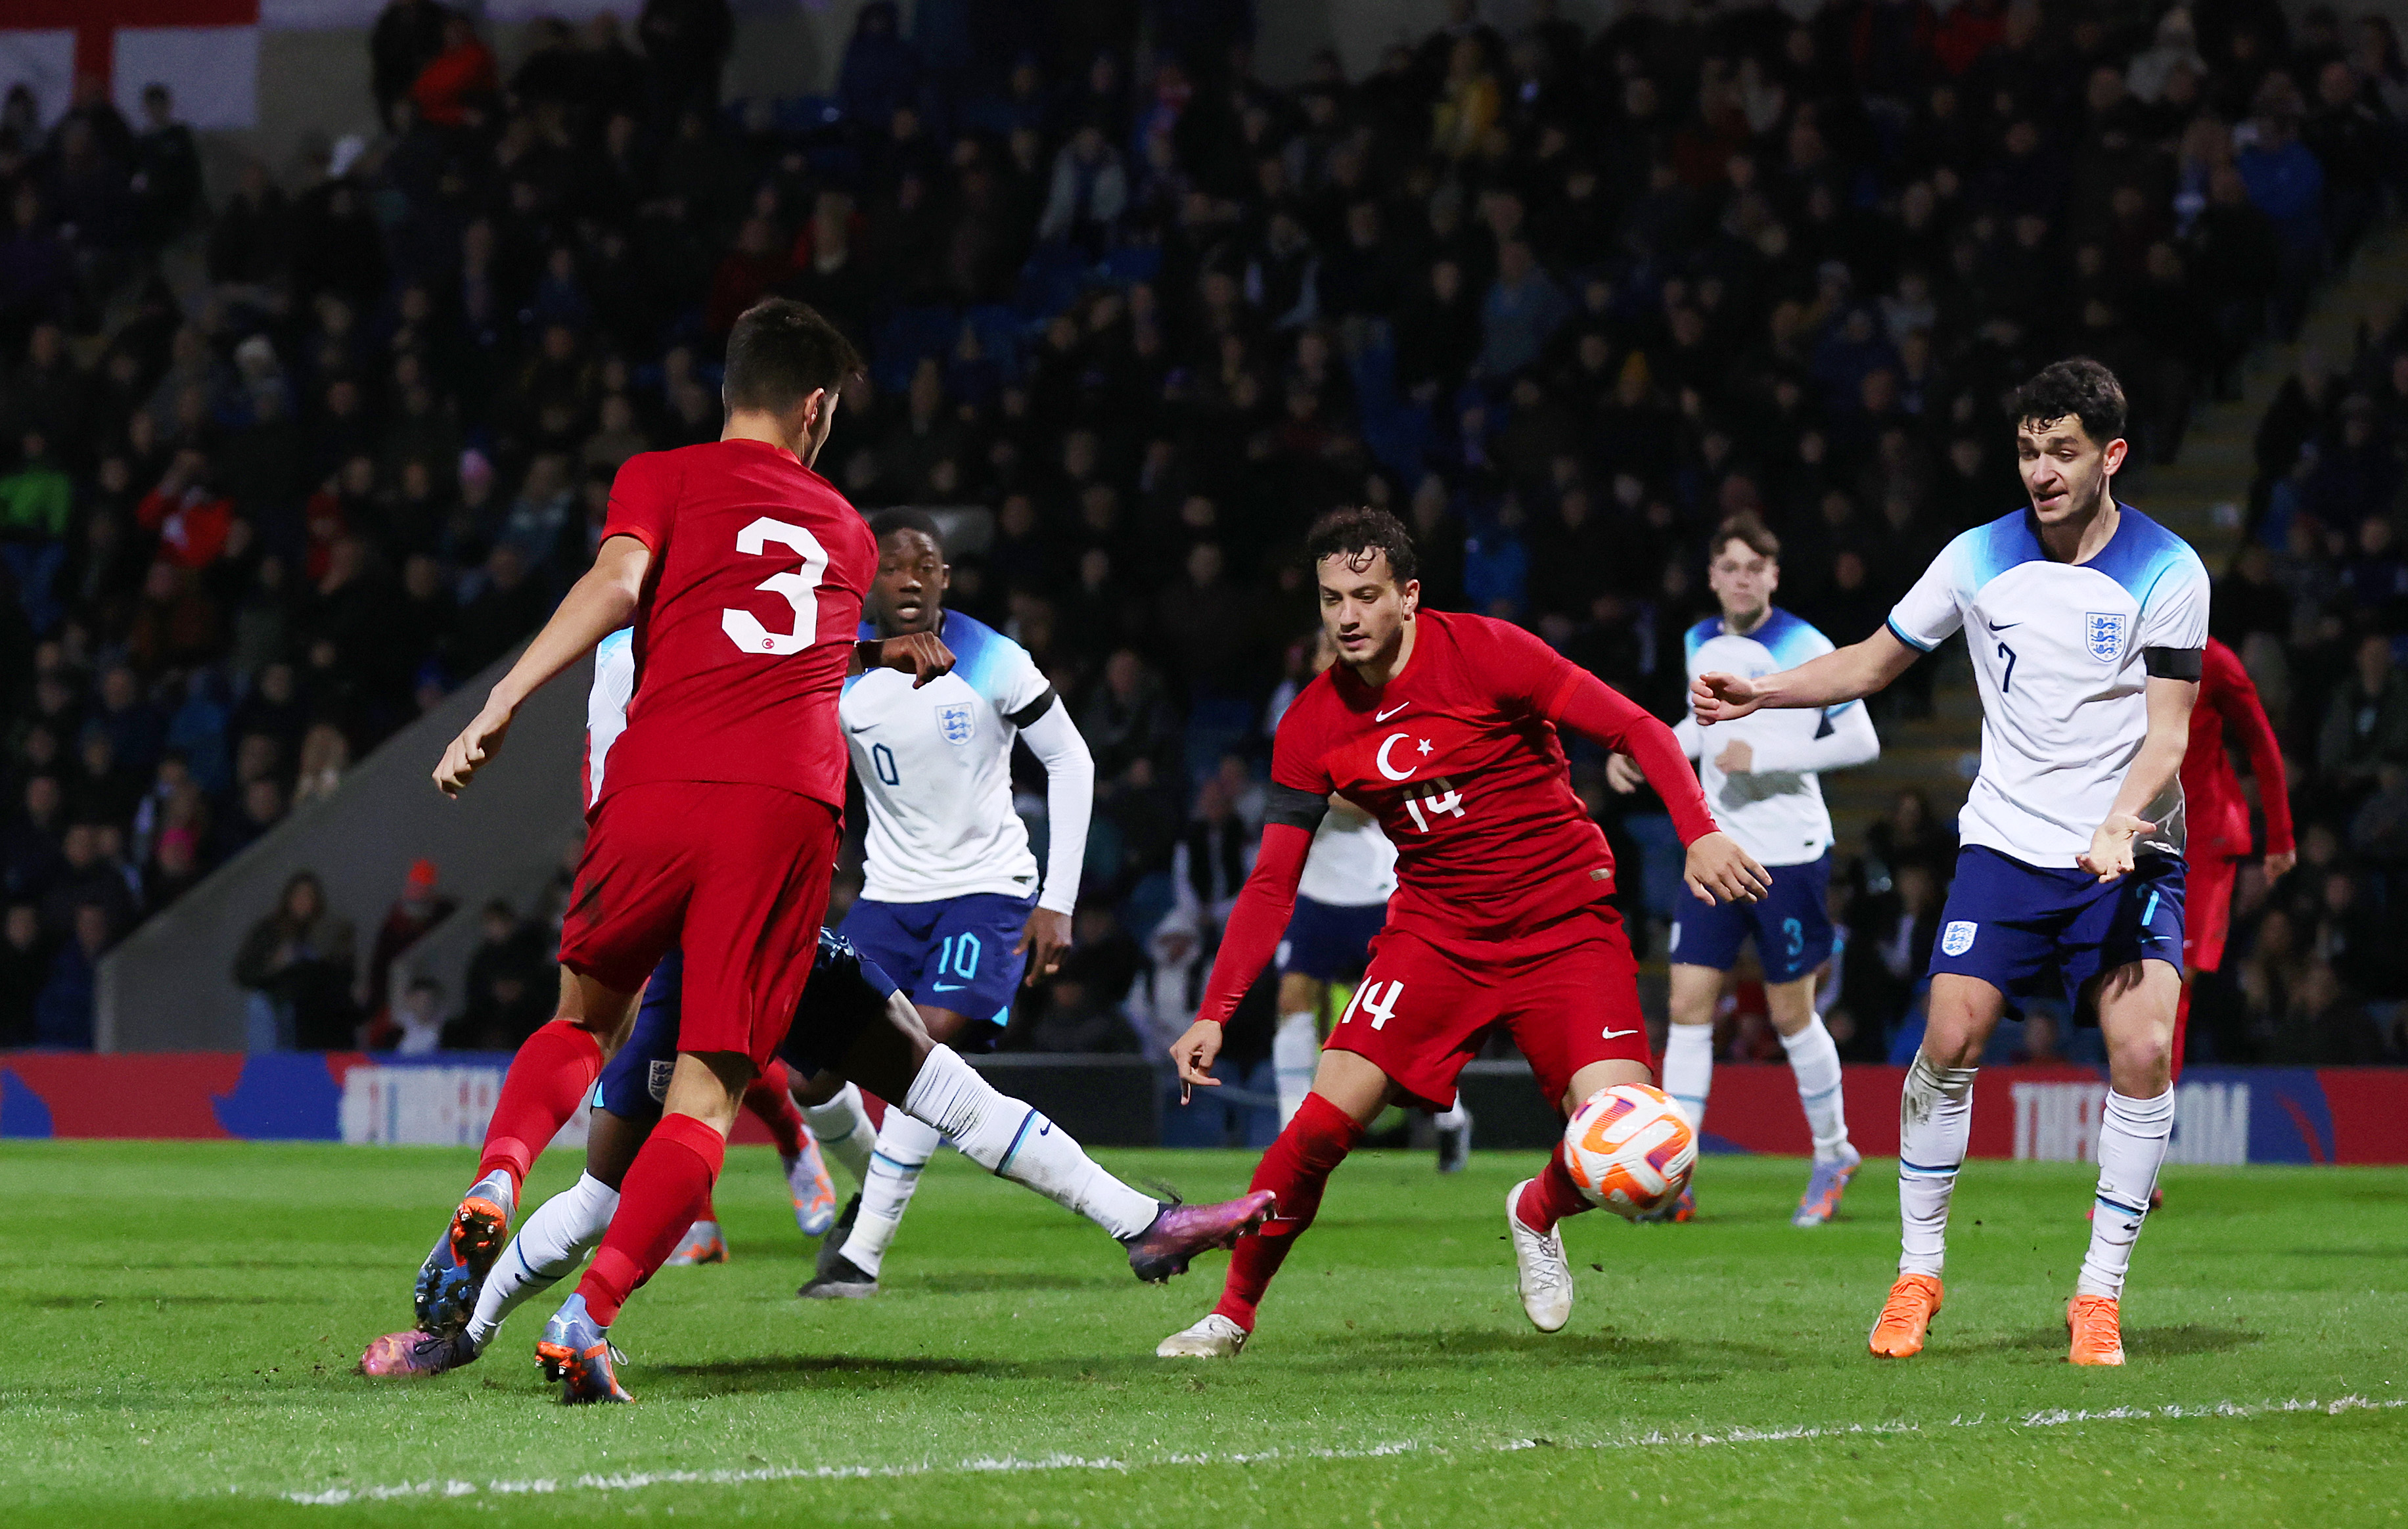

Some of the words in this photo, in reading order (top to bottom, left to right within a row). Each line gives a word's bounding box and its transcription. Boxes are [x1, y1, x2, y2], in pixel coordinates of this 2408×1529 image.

[721, 516, 829, 656] 3
[1998, 641, 2016, 693] 7
[1403, 777, 1465, 833] 14
[939, 932, 981, 980] 10
[1783, 918, 1803, 956] 3
[1342, 976, 1405, 1030] 14
